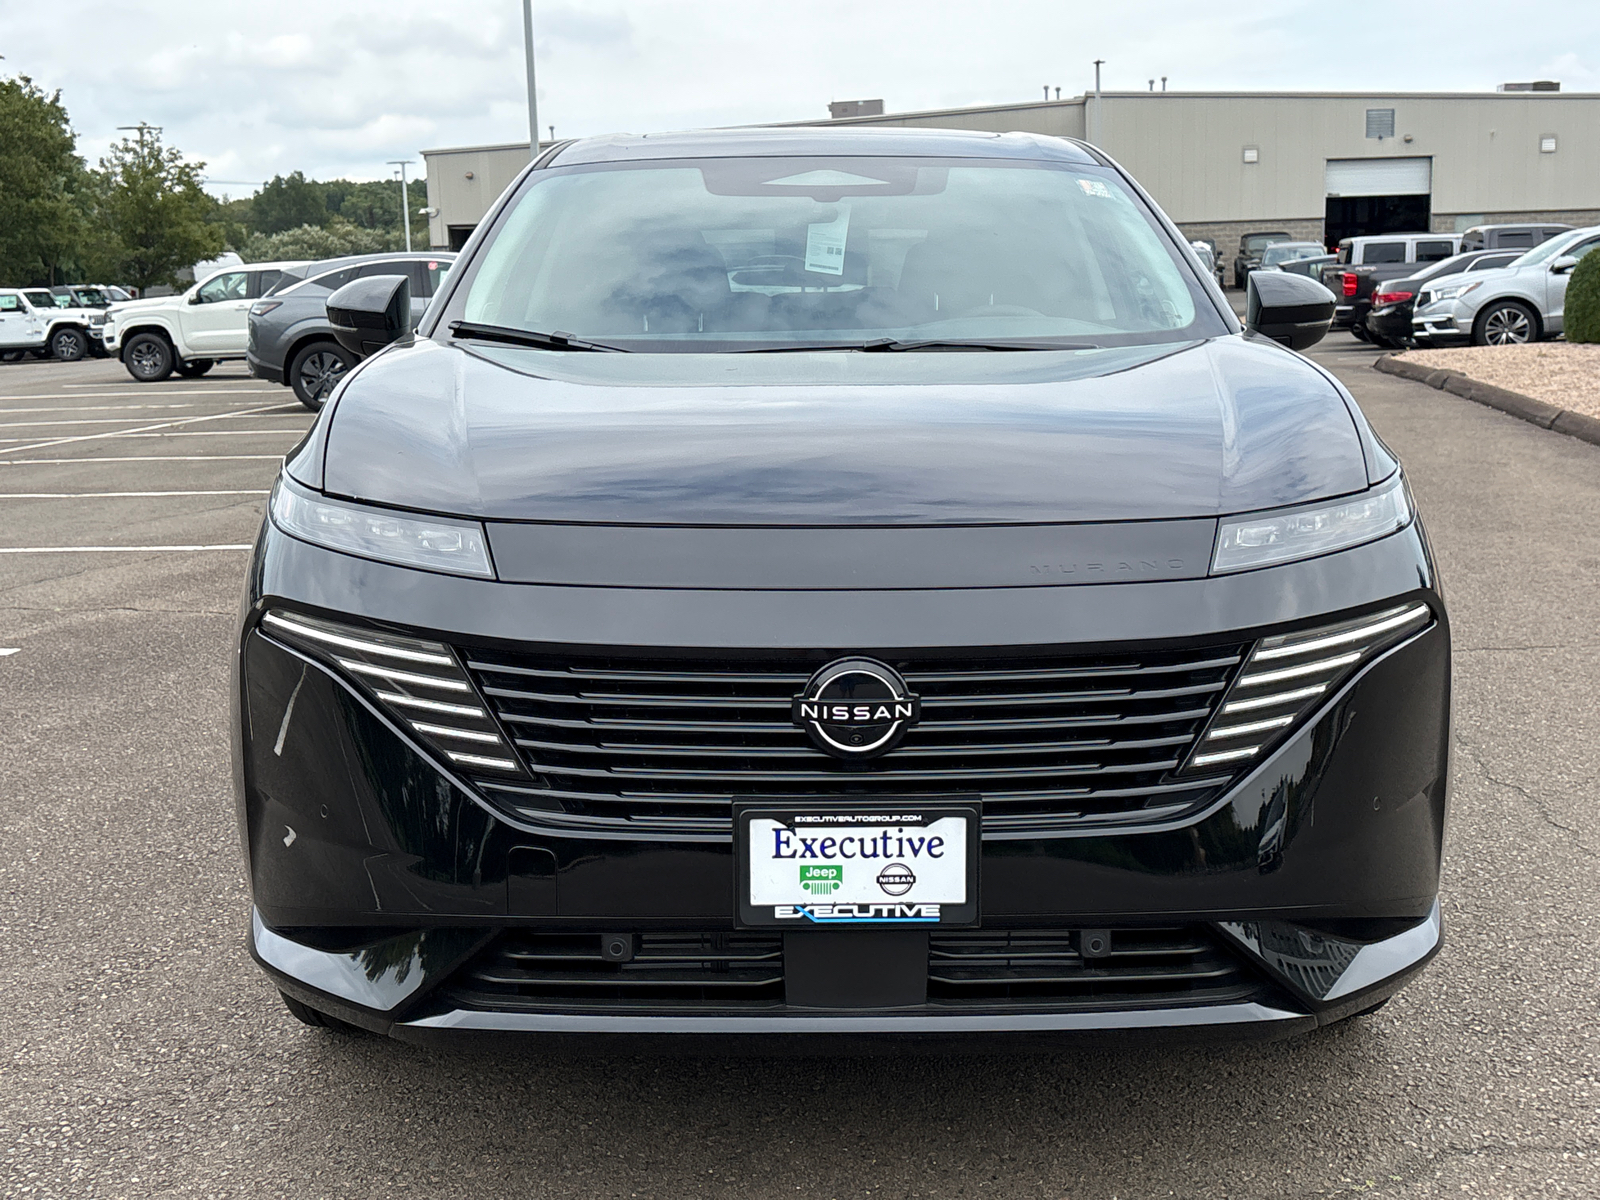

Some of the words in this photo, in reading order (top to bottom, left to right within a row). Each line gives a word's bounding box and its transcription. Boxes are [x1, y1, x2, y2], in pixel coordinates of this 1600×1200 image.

[1030, 559, 1184, 575] MURANO
[801, 703, 912, 720] NISSAN
[794, 814, 922, 823] EXECUTIVEAUTOGROUP.COM
[772, 827, 945, 859] Executive
[805, 867, 837, 879] Jeep
[774, 904, 941, 919] EXECUTIVE
